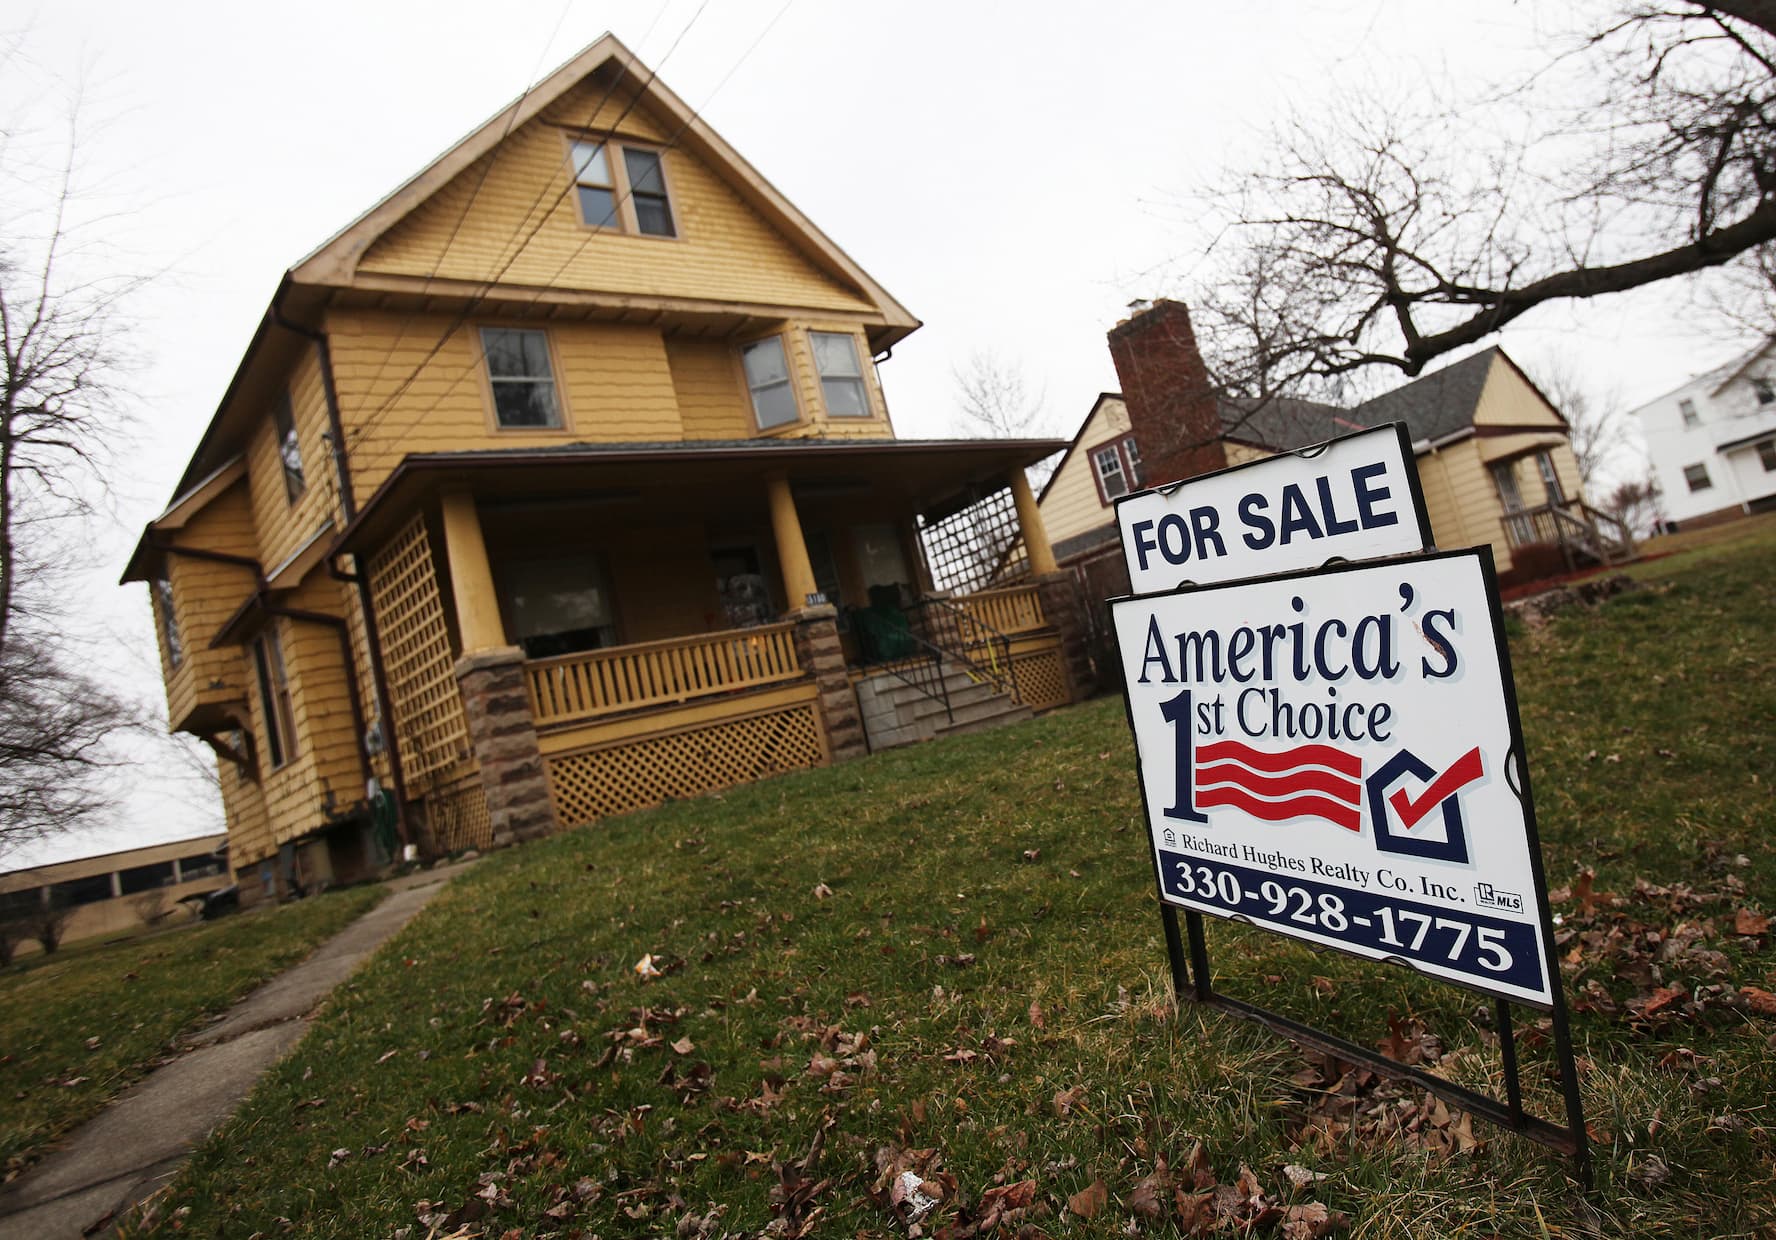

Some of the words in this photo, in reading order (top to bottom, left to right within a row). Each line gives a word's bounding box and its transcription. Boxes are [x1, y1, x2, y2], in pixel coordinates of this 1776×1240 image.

[1131, 505, 1228, 571] FOR
[1237, 461, 1399, 551] SALE
[1137, 582, 1459, 684] America's
[1236, 686, 1392, 742] Choice
[1181, 833, 1239, 859] Richard
[1241, 844, 1306, 872] Hughes
[1310, 856, 1370, 888] Realty
[1376, 869, 1414, 893] Co.
[1418, 875, 1466, 903] Inc.
[1497, 895, 1521, 909] MLS
[1174, 861, 1514, 972] 330-928-1775
